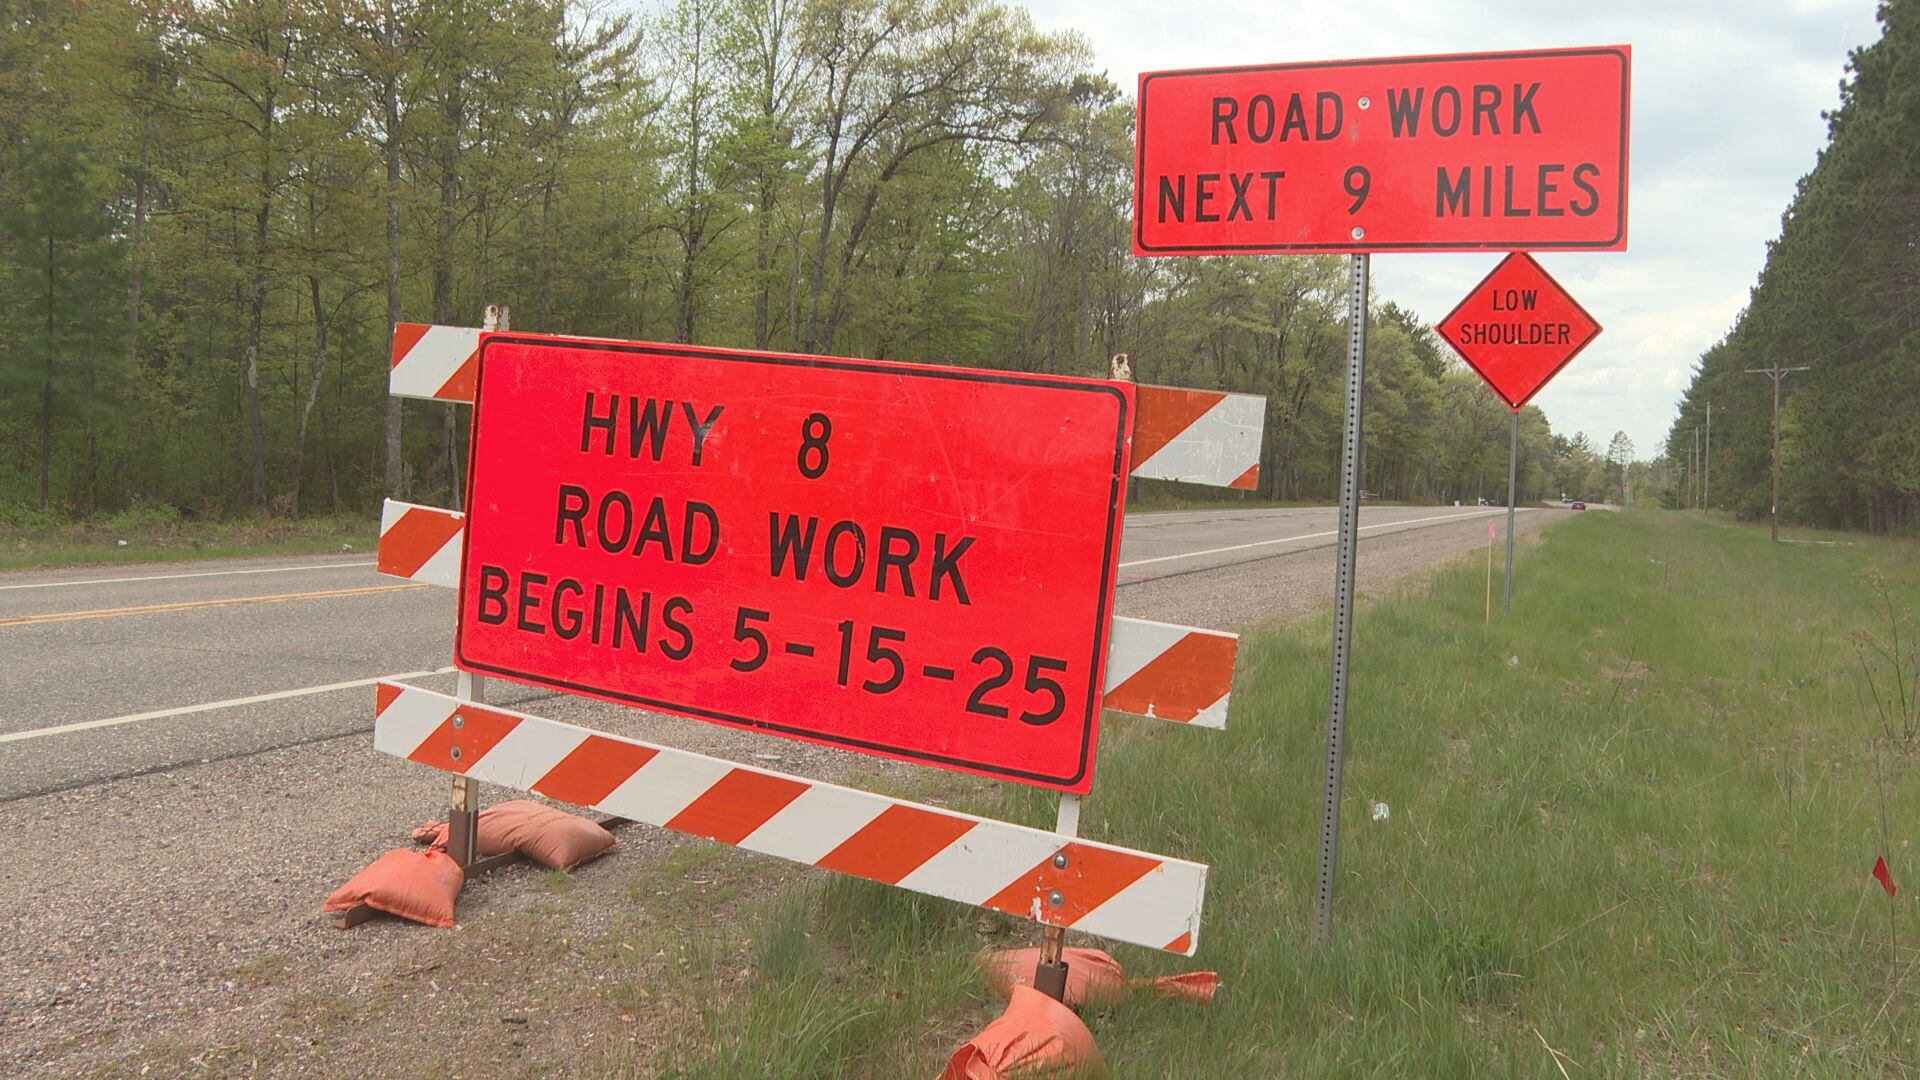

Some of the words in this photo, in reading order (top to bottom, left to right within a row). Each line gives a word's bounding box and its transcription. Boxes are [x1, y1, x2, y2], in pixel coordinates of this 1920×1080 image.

[1211, 92, 1344, 145] ROAD
[1386, 82, 1542, 138] WORK
[1158, 171, 1285, 223] NEXT
[1343, 165, 1371, 215] 9
[1435, 162, 1601, 218] MILES
[1492, 289, 1538, 312] LOW
[1460, 323, 1571, 345] SHOULDER
[580, 391, 724, 467] HWY
[798, 412, 832, 480] 8
[554, 484, 720, 566] ROAD
[769, 511, 976, 606] WORK
[477, 564, 694, 661] BEGINS
[730, 607, 1067, 726] 5-15-25
